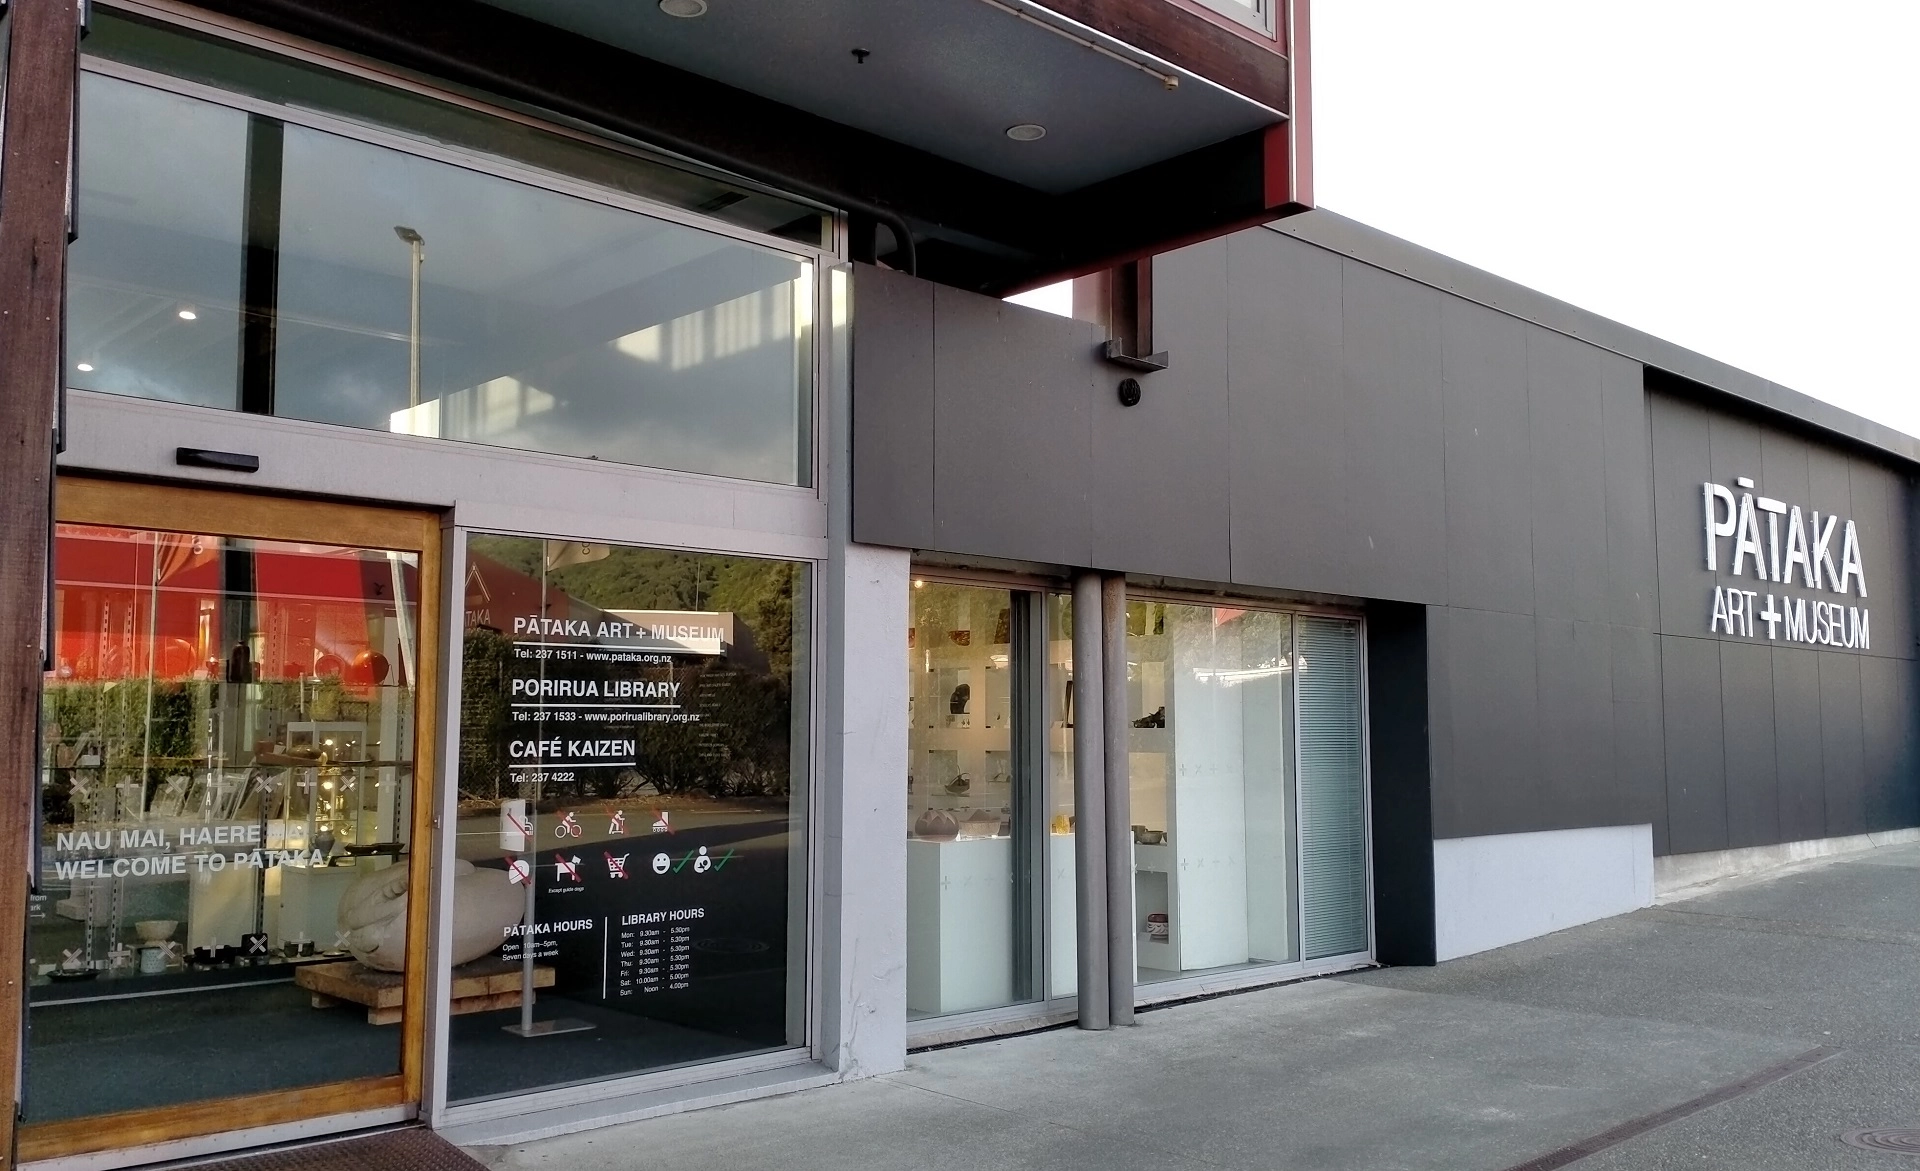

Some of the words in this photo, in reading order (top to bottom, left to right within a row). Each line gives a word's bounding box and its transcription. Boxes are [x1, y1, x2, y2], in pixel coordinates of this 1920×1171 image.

[1703, 476, 1868, 598] PĀTAKA
[464, 608, 491, 627] TAKA
[1711, 585, 1758, 638] ART
[1760, 594, 1782, 640] +
[1784, 595, 1870, 650] MUSEUM
[513, 615, 591, 637] PĀTAKA
[597, 622, 633, 639] ART
[636, 628, 646, 639] +
[651, 624, 724, 643] MUSEUM
[514, 648, 533, 659] Tel:
[535, 649, 553, 660] 237
[556, 649, 577, 661] 1511
[586, 651, 672, 664] www.pataka.org.nz
[512, 678, 599, 698] PORIRUA
[604, 681, 681, 699] LIBRARY
[512, 711, 531, 722] Tel:
[533, 711, 551, 722] 237
[554, 711, 576, 722] 1533
[584, 711, 700, 724] www.porirualibrary.org.nz
[509, 736, 562, 758] CAFÉ
[568, 739, 635, 757] KAIZEN
[510, 772, 529, 783] Tel:
[532, 772, 550, 782] 237
[551, 771, 575, 782] 4222
[56, 830, 112, 852] NAU
[120, 828, 171, 851] MAI,
[180, 824, 261, 846] HAERE
[55, 855, 187, 880] WELCOME
[194, 853, 226, 873] TO
[234, 847, 324, 870] PĀTAKA
[563, 886, 573, 894] guide
[622, 912, 667, 926] LIBRARY
[669, 908, 705, 921] HOURS
[503, 923, 551, 937] PĀTAKA
[553, 919, 593, 932] HOURS
[502, 943, 519, 952] Open
[502, 953, 521, 961] Seven
[523, 951, 537, 960] days
[543, 949, 559, 957] week
[620, 989, 633, 997] Sun:
